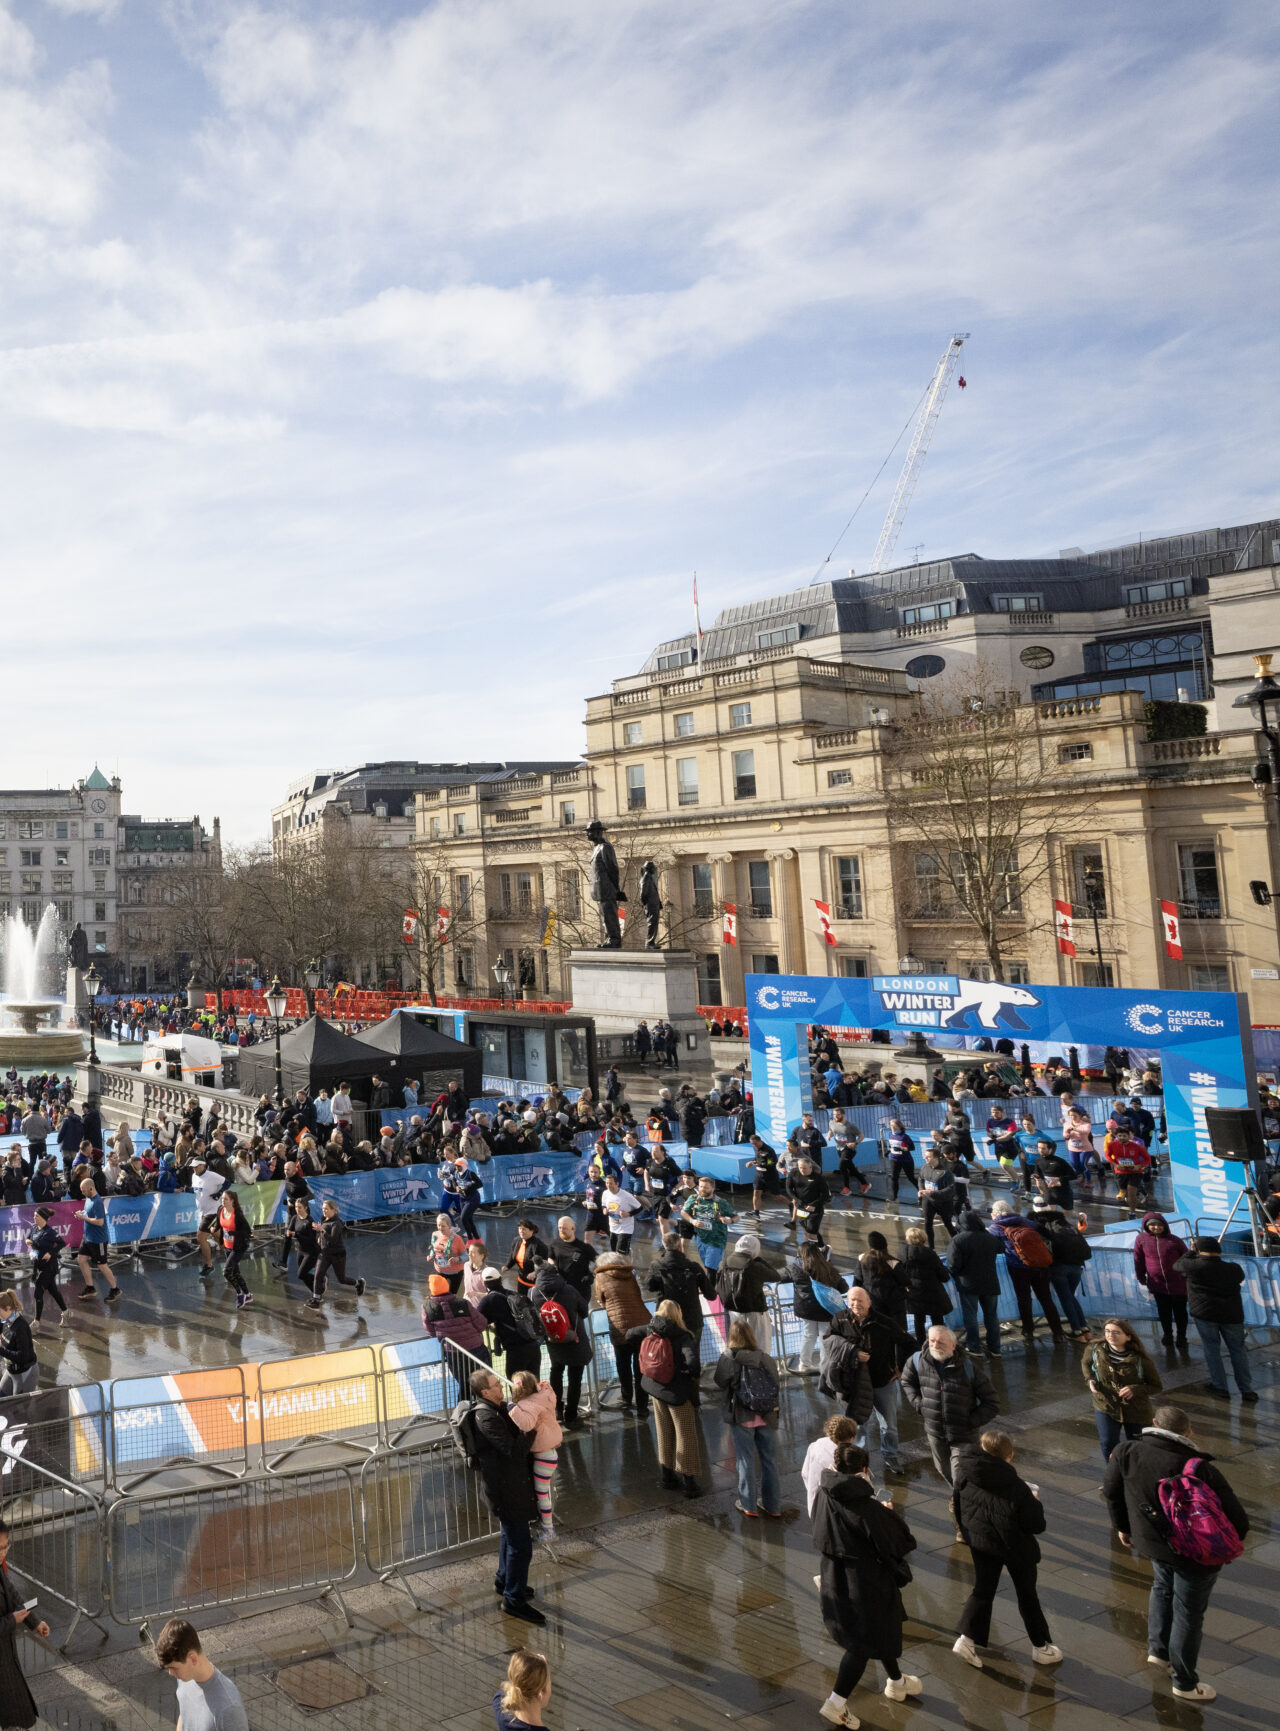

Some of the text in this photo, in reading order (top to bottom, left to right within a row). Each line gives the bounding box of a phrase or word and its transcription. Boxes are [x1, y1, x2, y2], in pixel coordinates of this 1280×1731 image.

[882, 978, 949, 992] LONDON
[781, 989, 808, 998] CANCER
[781, 996, 816, 1004] RESEARCH
[782, 1001, 792, 1009] UK
[883, 993, 952, 1010] WINTER
[899, 1011, 937, 1026] RUN
[1167, 1009, 1211, 1019] CANCER
[1168, 1017, 1224, 1028] RESEARCH
[1169, 1025, 1183, 1033] UK
[111, 1213, 141, 1226] HOKA
[175, 1211, 195, 1224] FLY
[2, 1228, 31, 1243] HUM
